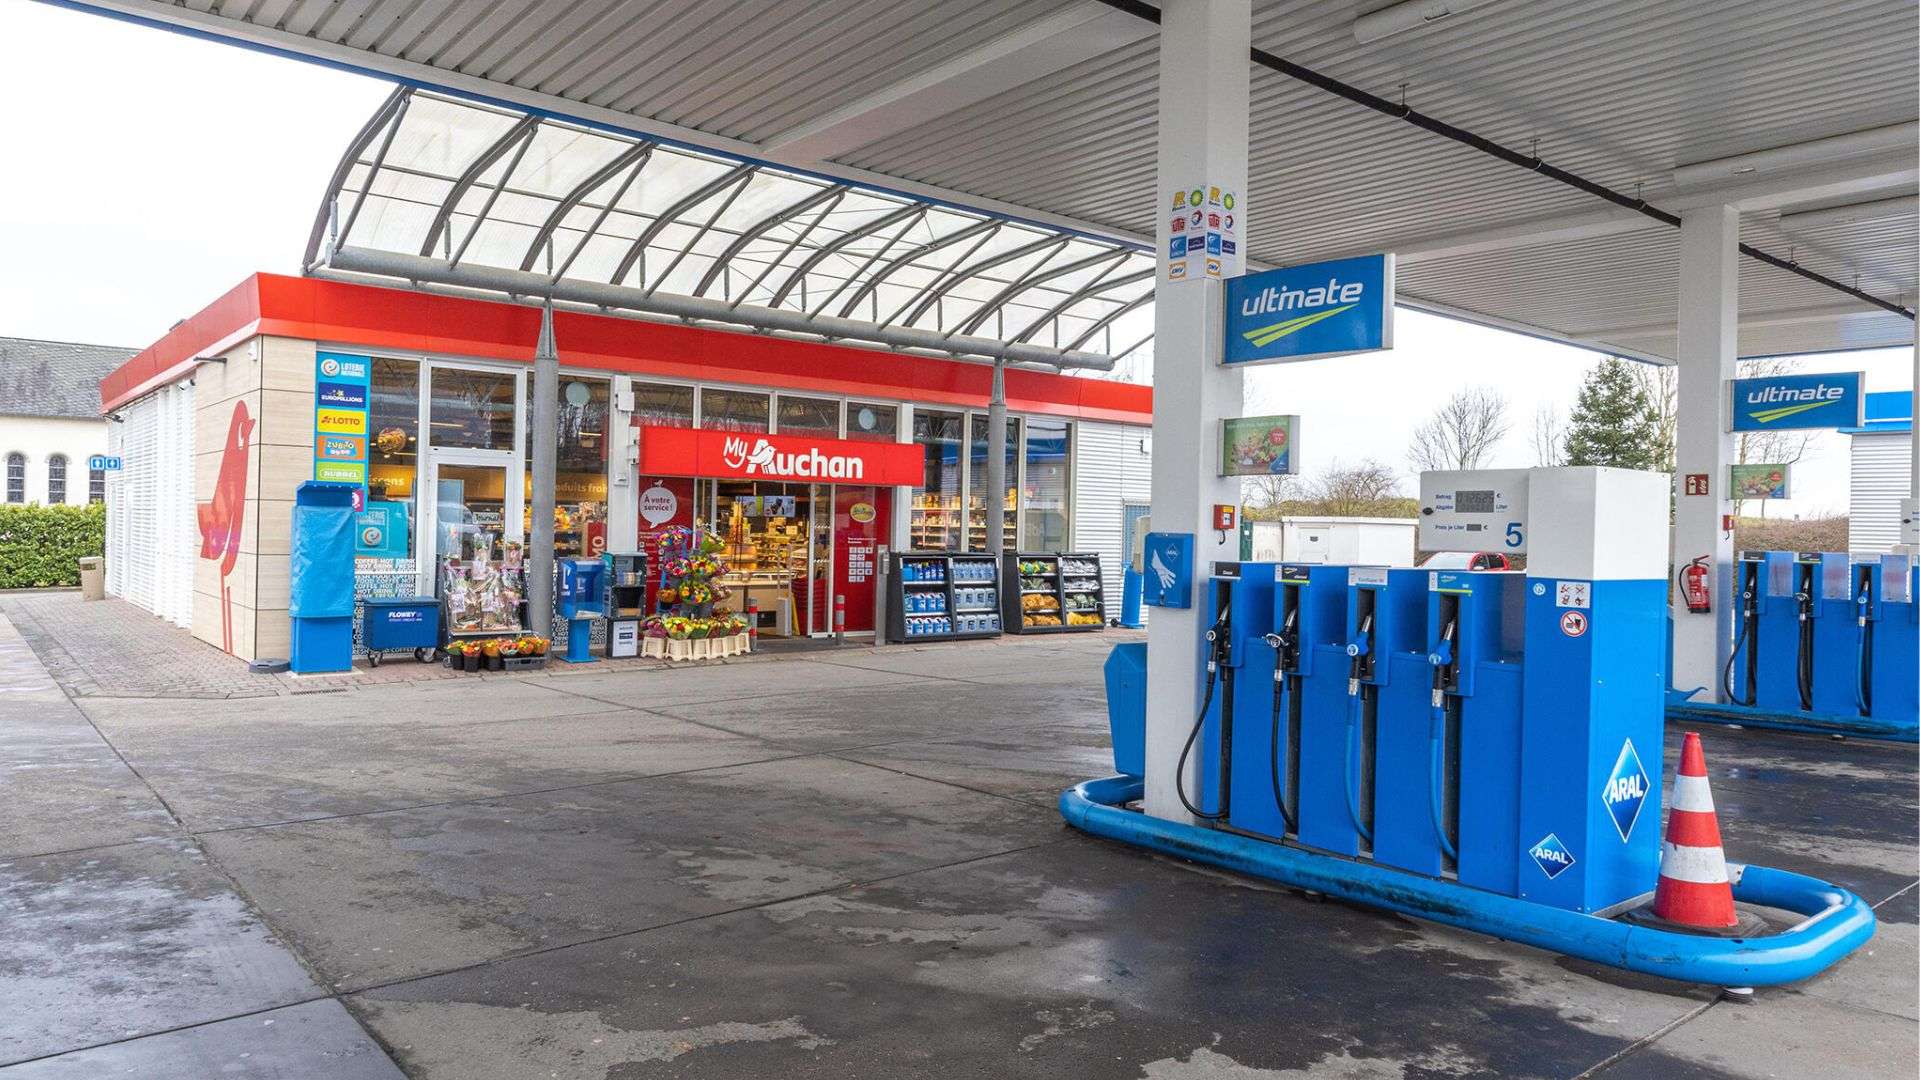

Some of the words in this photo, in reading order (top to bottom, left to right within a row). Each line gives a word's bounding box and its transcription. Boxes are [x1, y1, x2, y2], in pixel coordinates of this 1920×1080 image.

[1242, 278, 1364, 316] ultimate
[1748, 384, 1845, 404] ultimate
[333, 416, 360, 426] LOTTO
[723, 436, 748, 468] My
[746, 438, 864, 479] Auchan
[1505, 522, 1523, 547] 5
[1609, 774, 1643, 804] ARAL
[1535, 847, 1569, 864] ARAL
